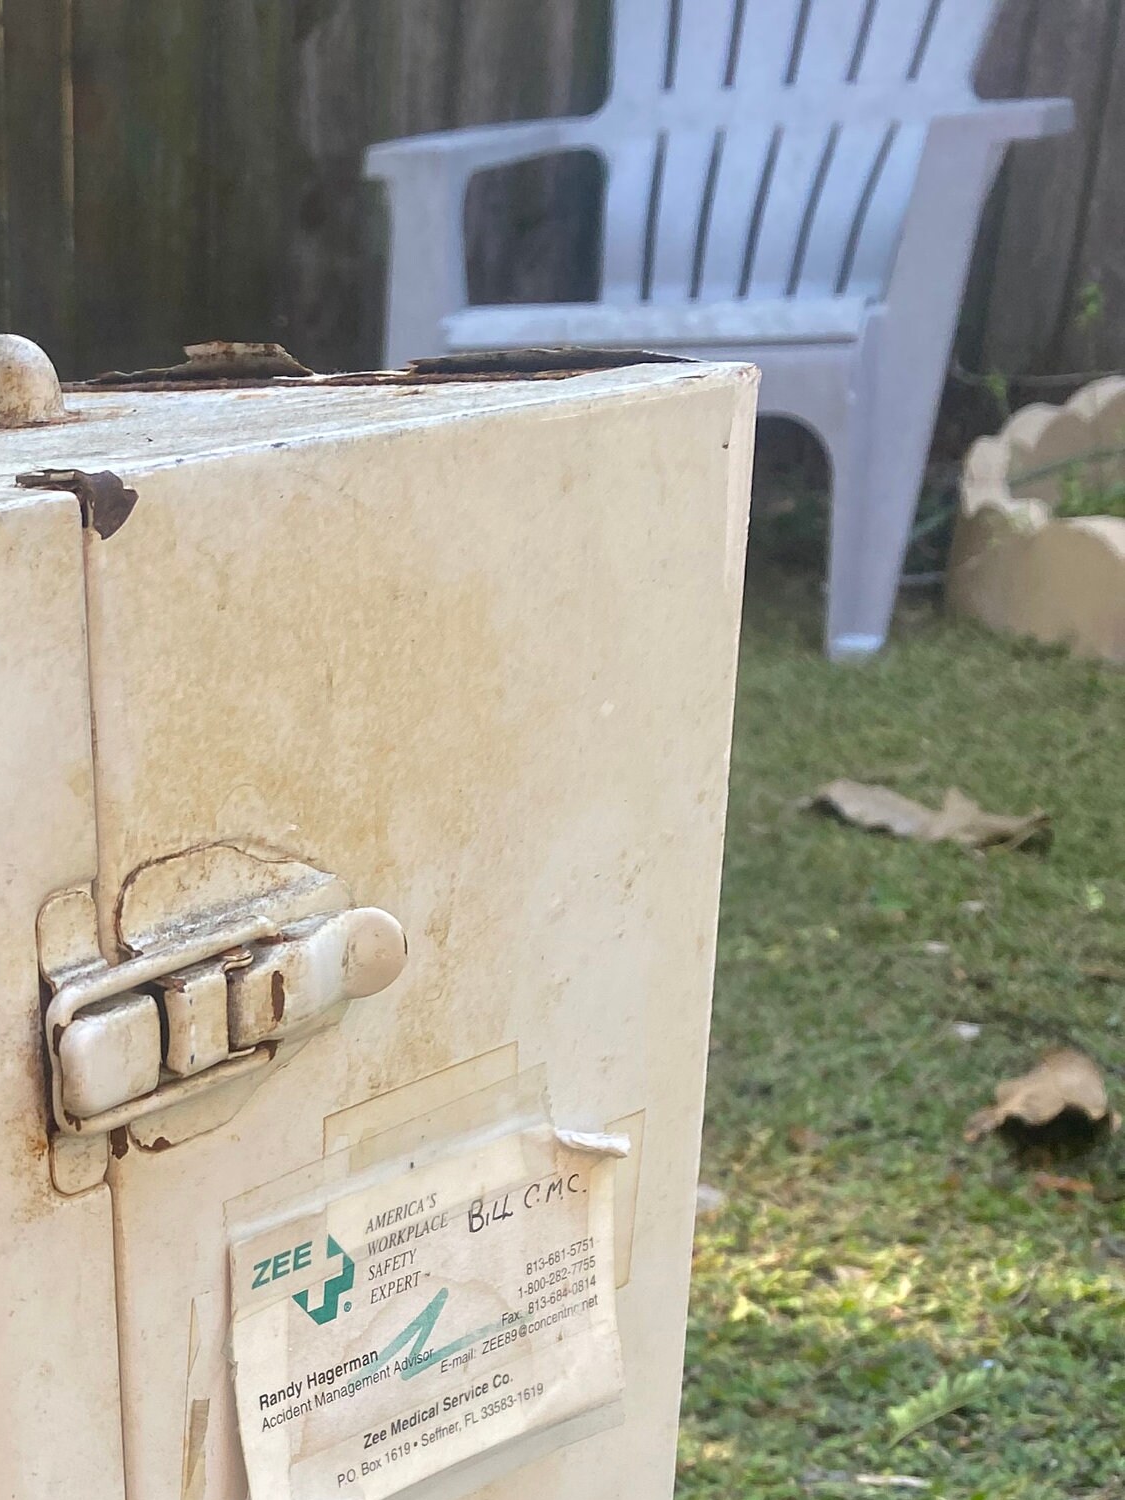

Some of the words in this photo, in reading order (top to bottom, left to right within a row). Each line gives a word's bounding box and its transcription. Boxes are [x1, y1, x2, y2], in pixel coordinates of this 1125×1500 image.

[366, 1193, 437, 1234] AMERICA'S
[367, 1211, 449, 1256] WORKPLACE
[251, 1240, 313, 1290] ZEE
[368, 1247, 417, 1281] SAFETY
[518, 1255, 596, 1299] 1-800-282-7755
[526, 1236, 595, 1275] 813-681-5751
[528, 1274, 597, 1315] 813-684-0814
[259, 1381, 302, 1411] Randy
[307, 1350, 379, 1390] Hagerman
[440, 1348, 477, 1374] E-mail:
[262, 1400, 313, 1432] Accident
[314, 1366, 391, 1409] Management
[393, 1348, 434, 1376] Advisor
[363, 1432, 387, 1449] Zee
[391, 1402, 439, 1436] Medical
[443, 1381, 489, 1412] Service
[492, 1371, 514, 1389] Co.
[361, 1457, 382, 1476] Box
[385, 1442, 411, 1464] 1619
[421, 1421, 462, 1447] Seffner,
[464, 1413, 479, 1428] FL
[480, 1382, 544, 1420] 33583-1619
